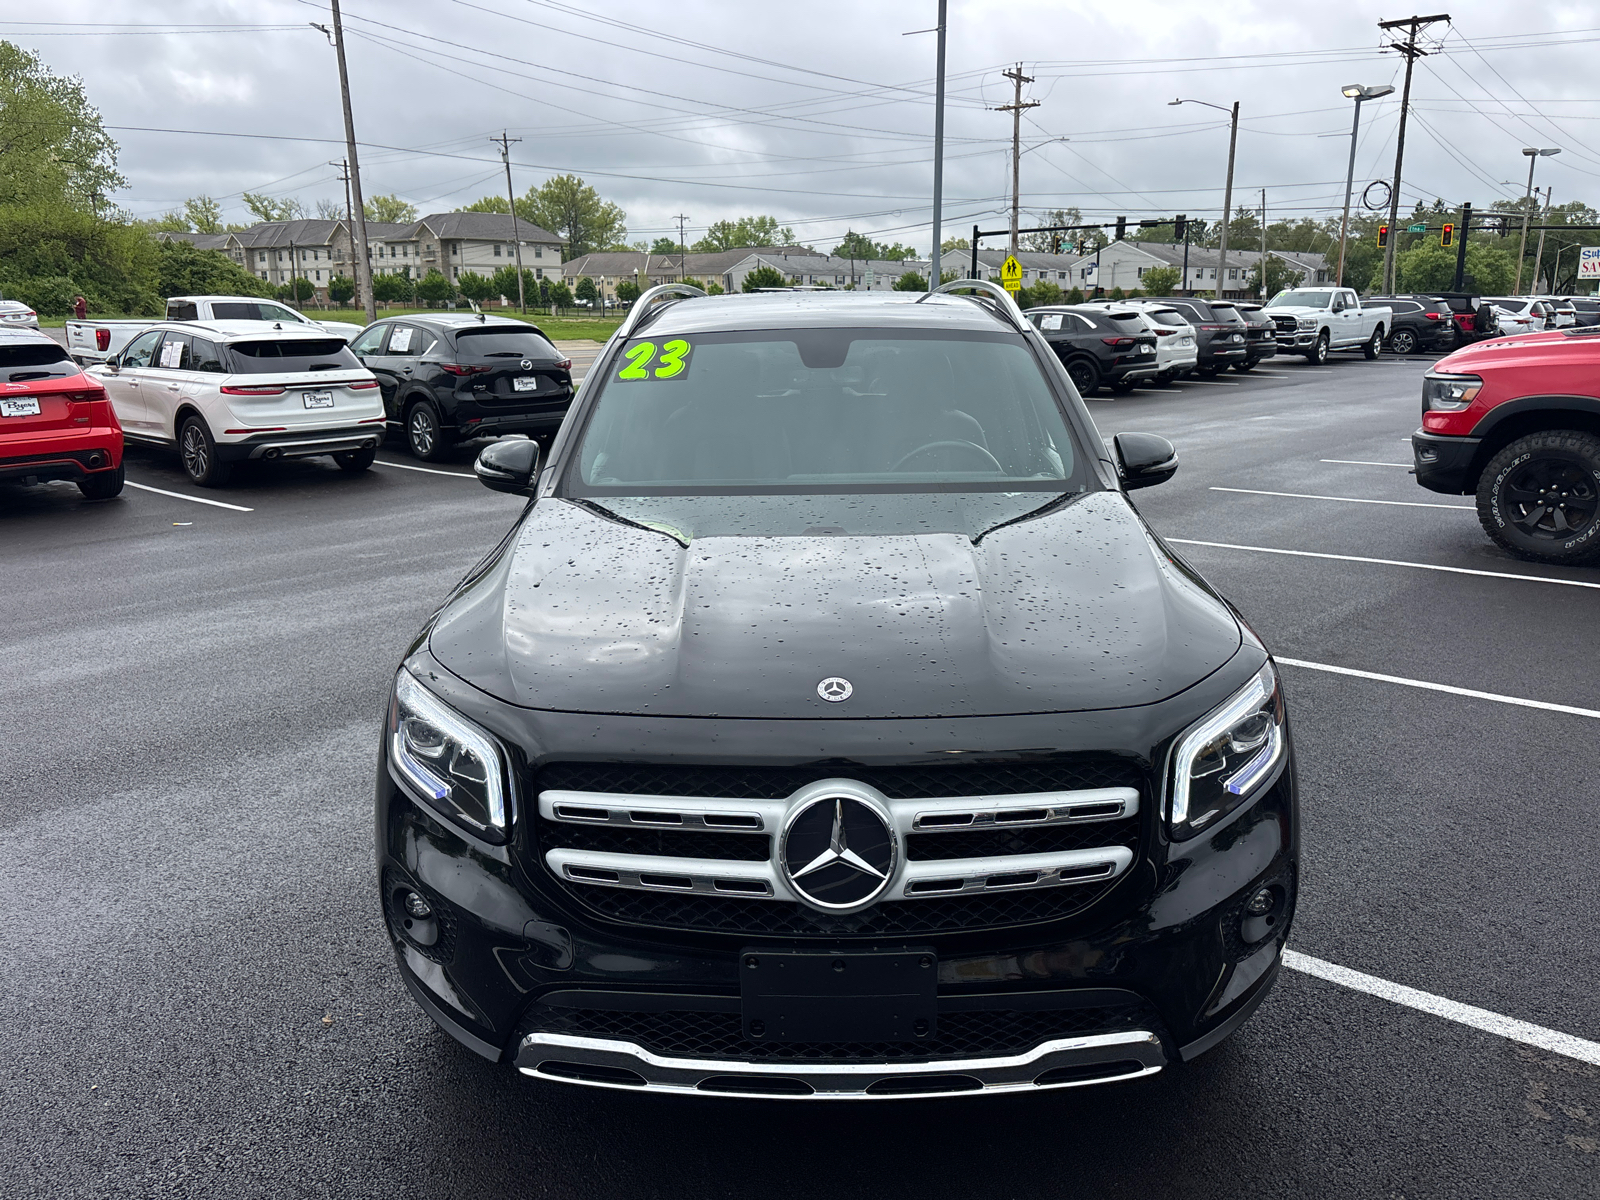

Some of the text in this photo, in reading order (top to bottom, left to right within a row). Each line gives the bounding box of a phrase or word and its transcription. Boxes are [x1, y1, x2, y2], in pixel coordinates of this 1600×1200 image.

[618, 339, 692, 380] 23
[3, 401, 36, 411] Byers
[1491, 453, 1531, 528] WRANGLER
